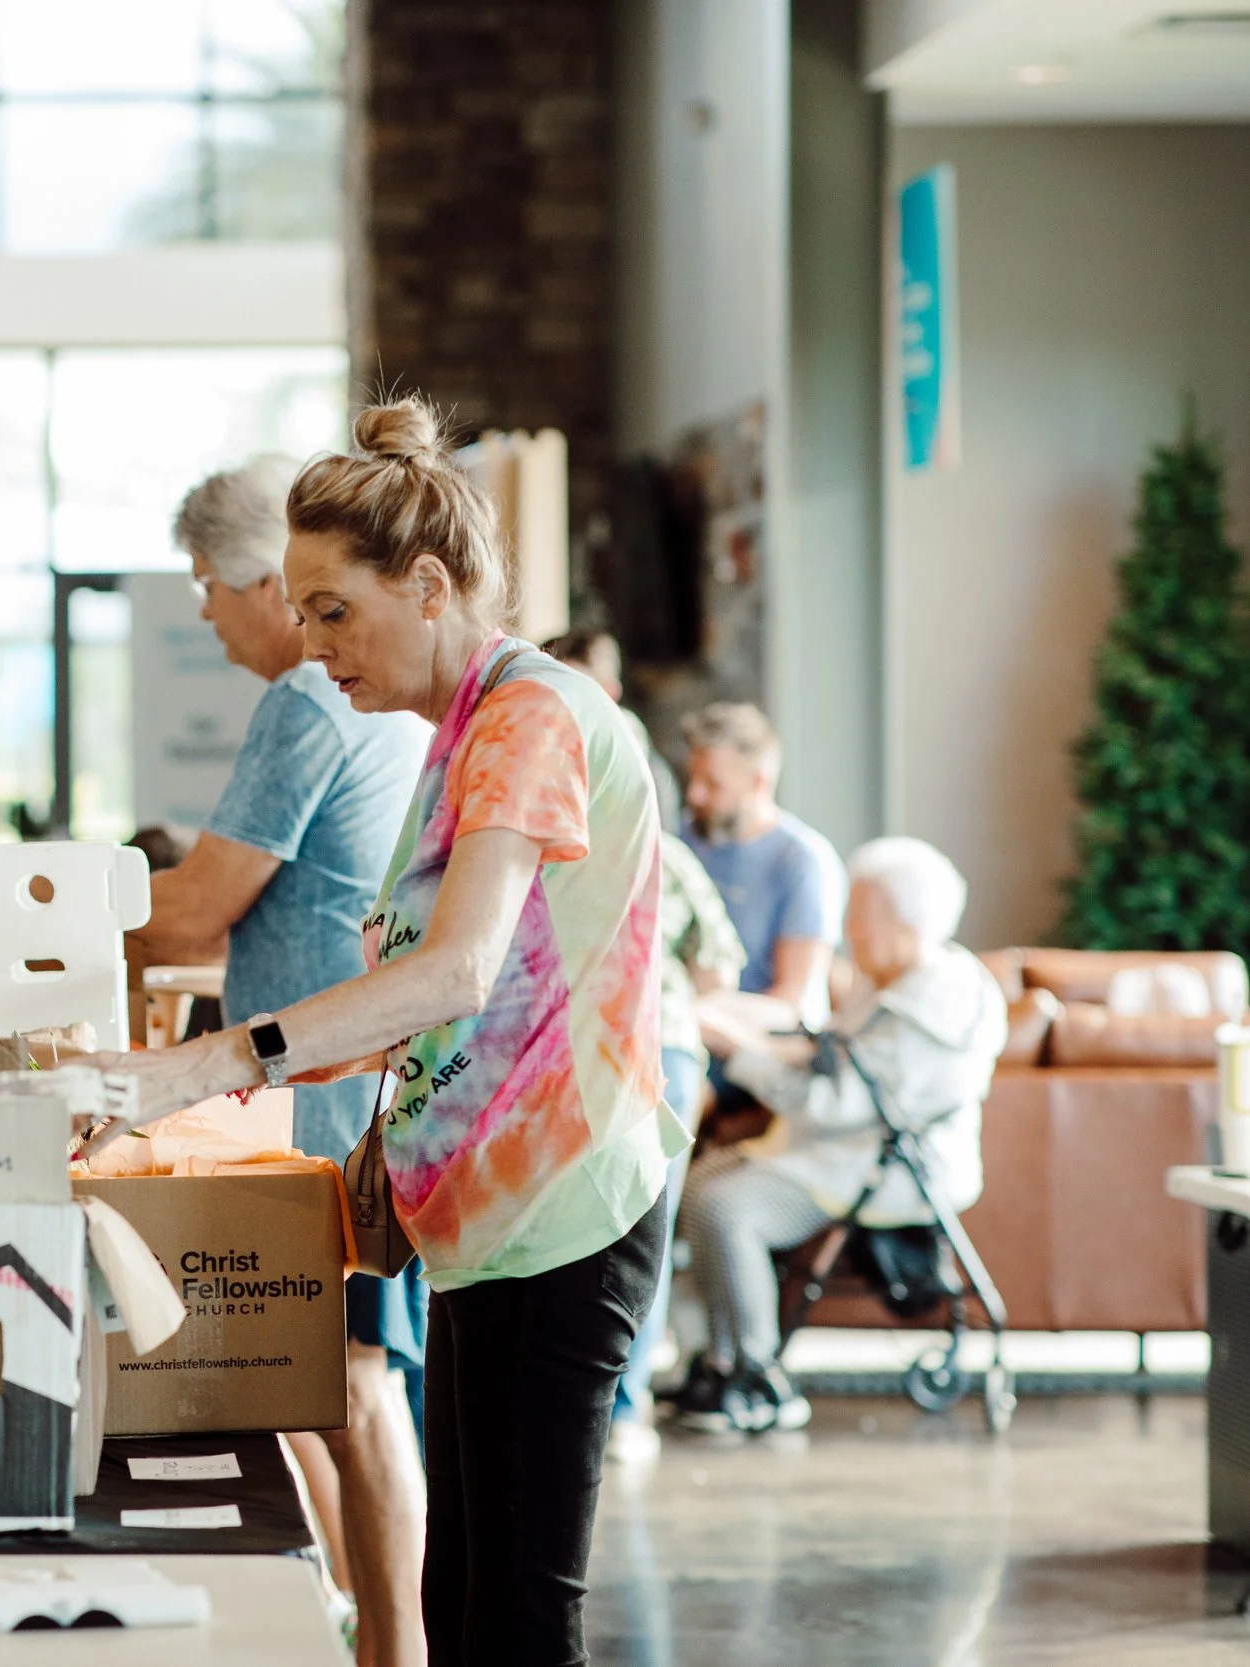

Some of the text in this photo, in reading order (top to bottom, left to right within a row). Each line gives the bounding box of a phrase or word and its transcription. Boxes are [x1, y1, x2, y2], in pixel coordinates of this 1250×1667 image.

[430, 1051, 472, 1094] ARE
[180, 1249, 260, 1273] Christ
[182, 1273, 323, 1301] Fellowship
[118, 1355, 293, 1371] www.christfellowship.church
